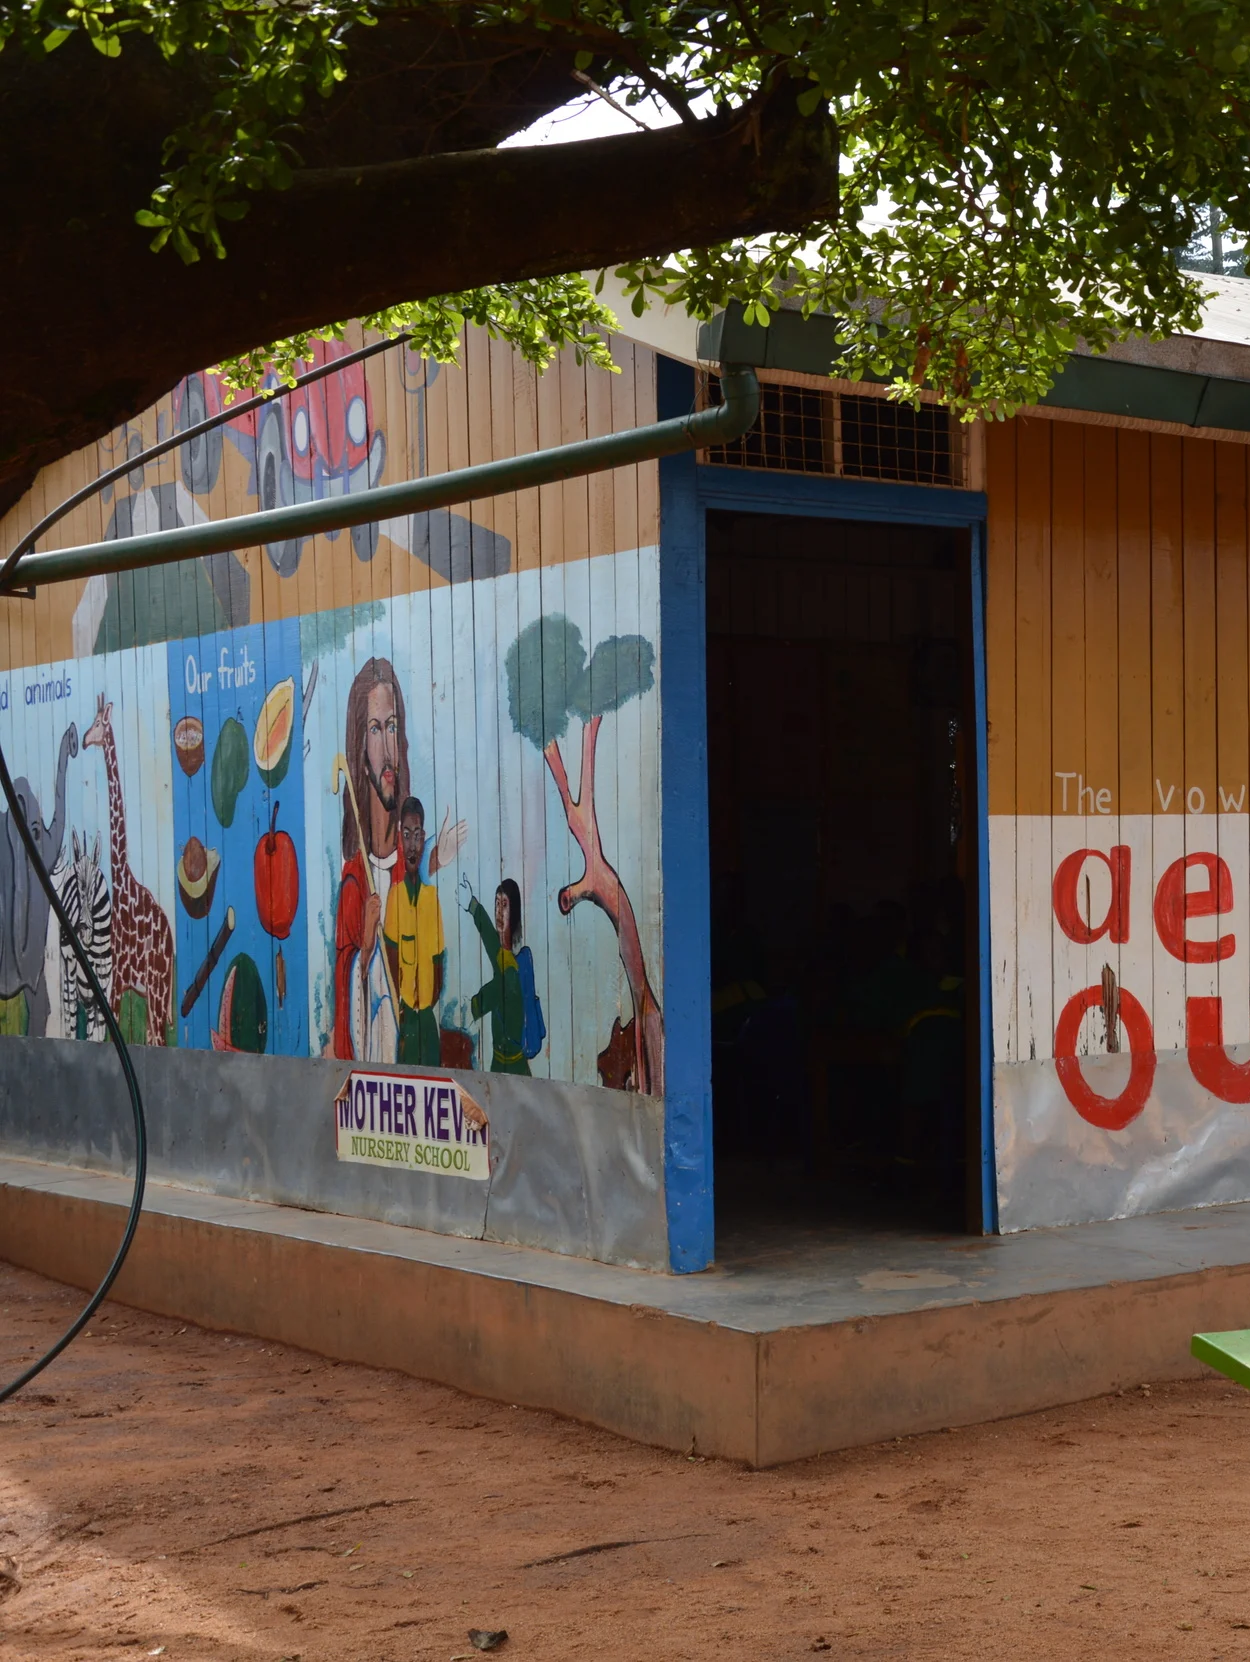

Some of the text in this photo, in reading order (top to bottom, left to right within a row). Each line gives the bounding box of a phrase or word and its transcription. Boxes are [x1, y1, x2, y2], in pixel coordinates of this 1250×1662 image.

[26, 668, 72, 706] animals
[186, 645, 256, 694] Our fruits
[1055, 771, 1112, 815] The
[1052, 844, 1132, 945] a
[1153, 851, 1237, 964] e
[340, 1079, 417, 1137] MOTHER
[351, 1136, 471, 1172] NURSERY SCHOOL
